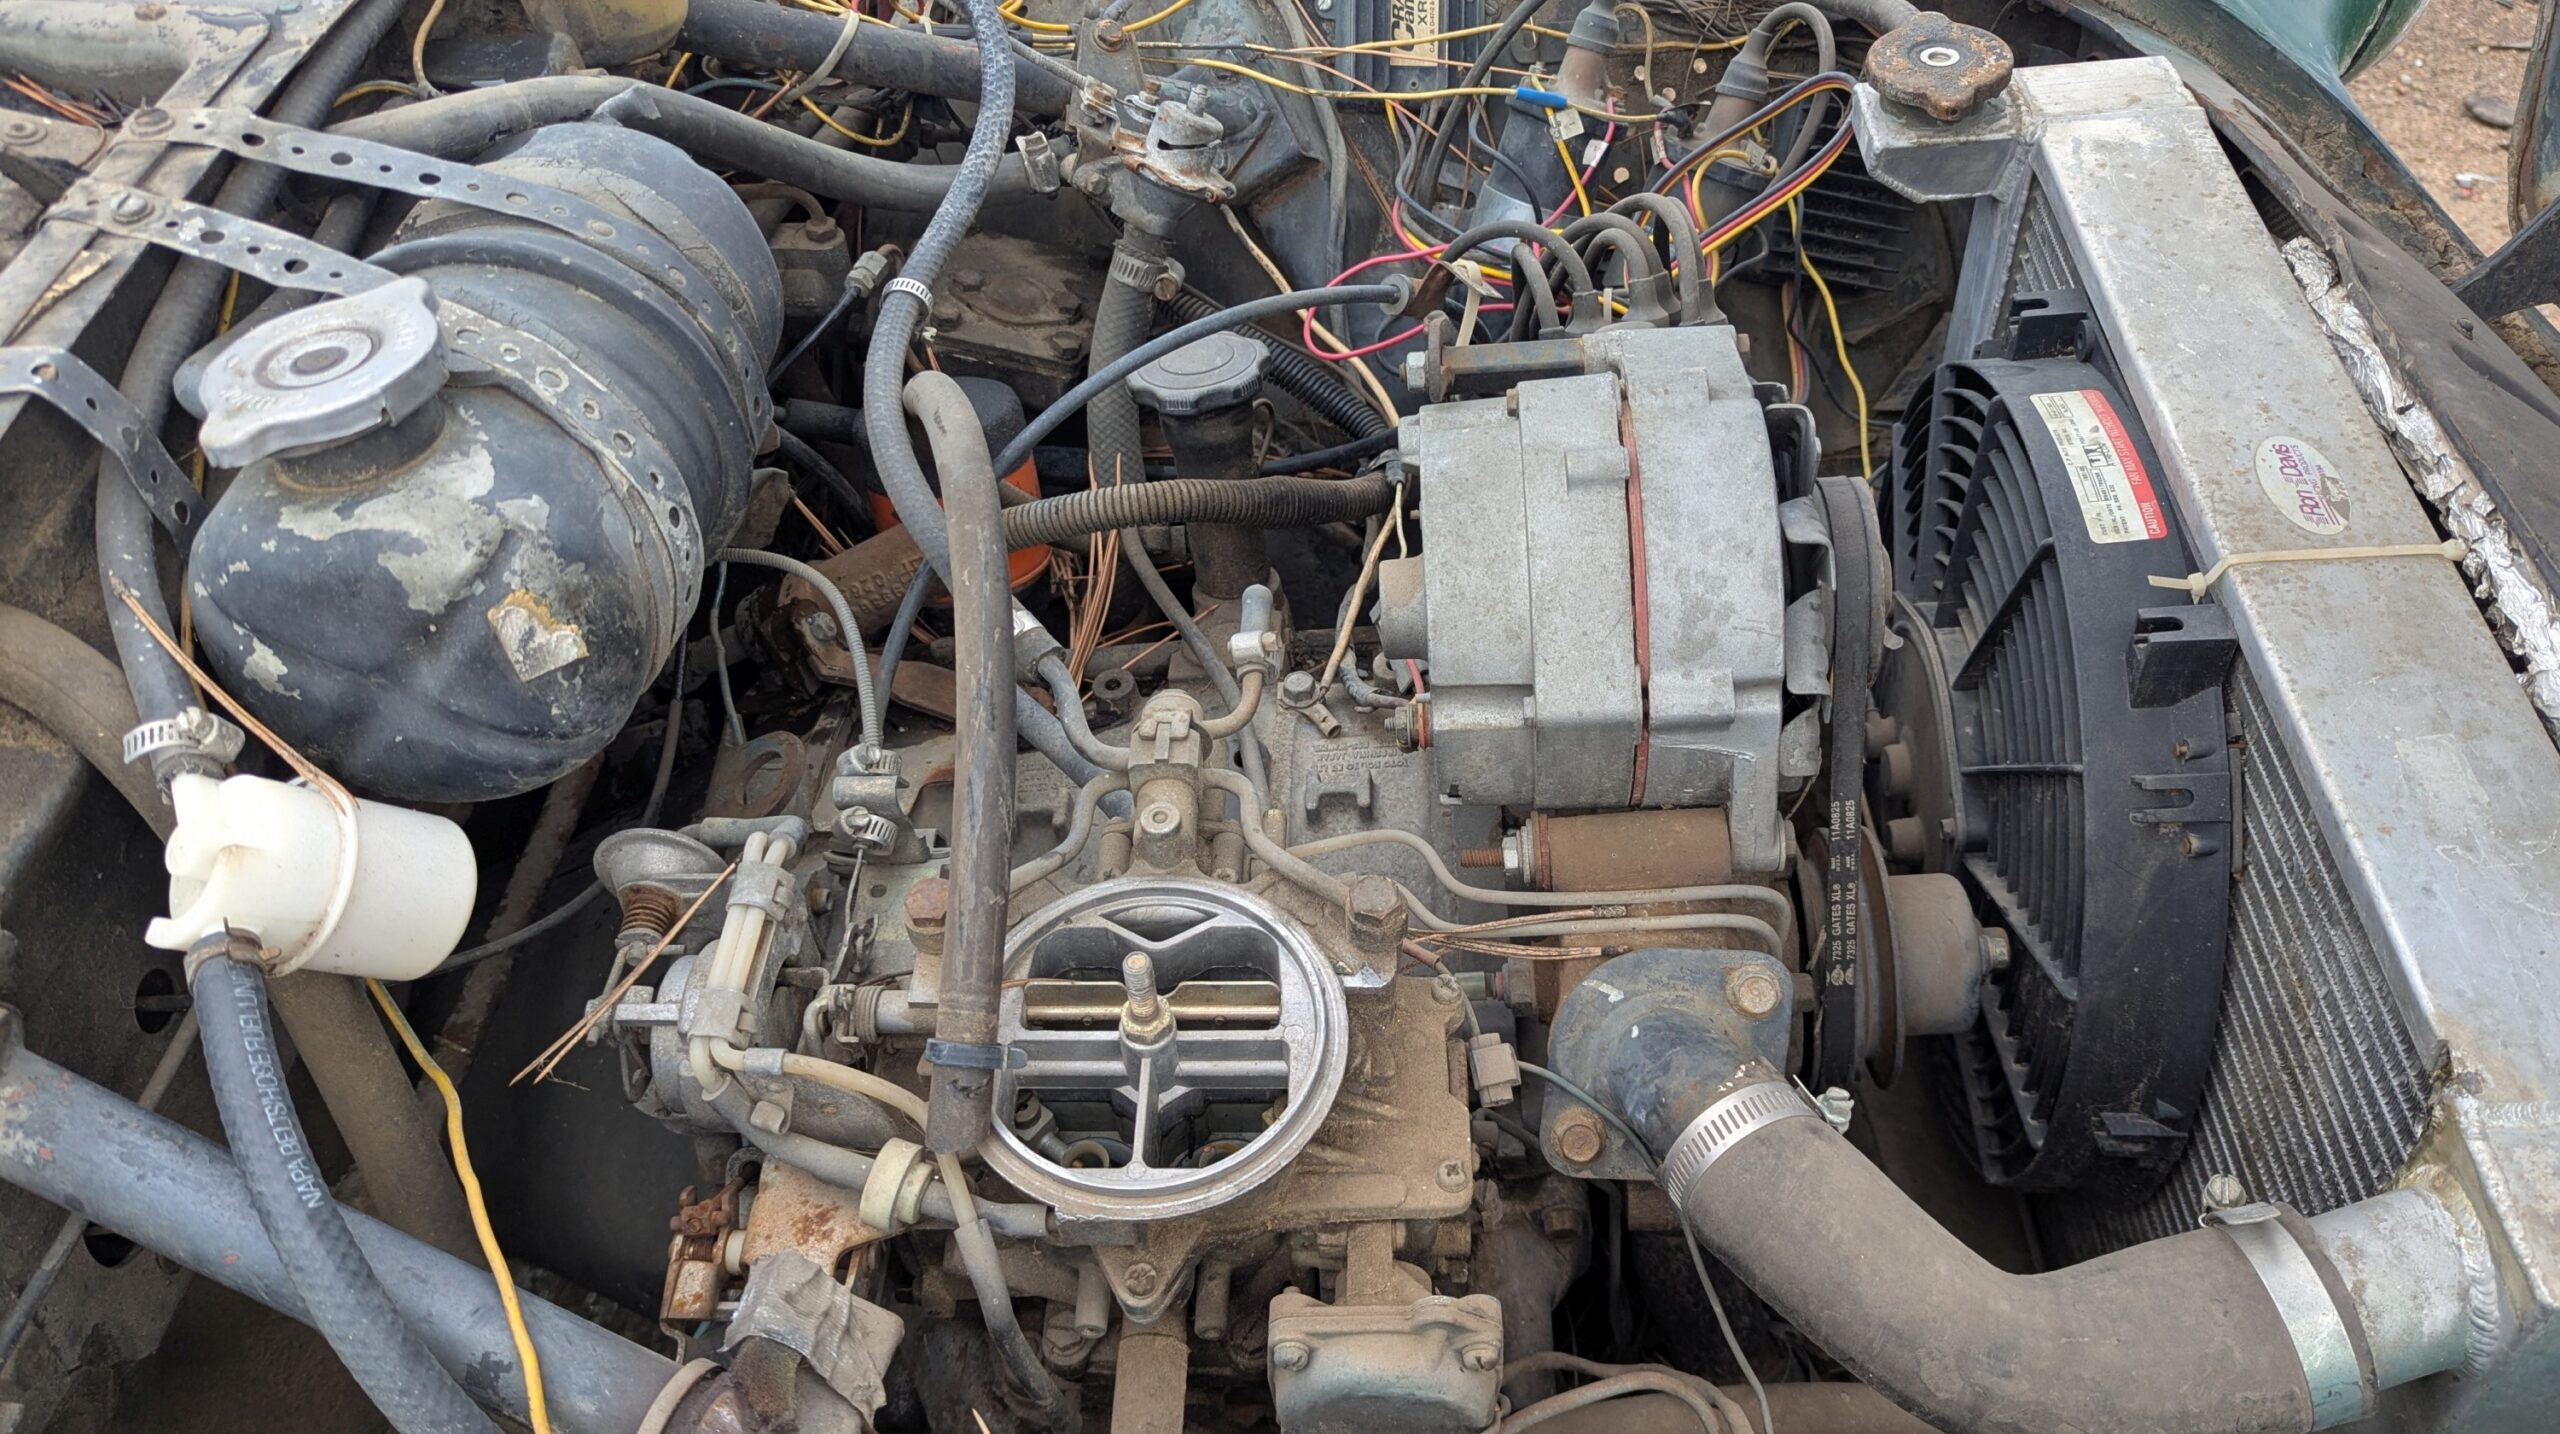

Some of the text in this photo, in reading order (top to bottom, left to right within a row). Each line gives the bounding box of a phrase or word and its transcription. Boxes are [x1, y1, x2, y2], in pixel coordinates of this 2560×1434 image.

[2114, 437, 2130, 457] START
[2272, 444, 2304, 477] Davis
[2123, 457, 2137, 471] MAY
[2129, 472, 2142, 485] FAN
[2140, 502, 2160, 534] CAUTION
[2296, 490, 2325, 516] Ron
[1831, 801, 1840, 842] 11A0825
[1845, 800, 1855, 840] 11A0825
[1832, 904, 1841, 936] GATES
[1846, 904, 1856, 935] GATES
[1833, 940, 1842, 961] 7325
[1846, 940, 1856, 960] 7325
[240, 1010, 270, 1052] FUEL
[288, 1157, 325, 1209] NAPA
